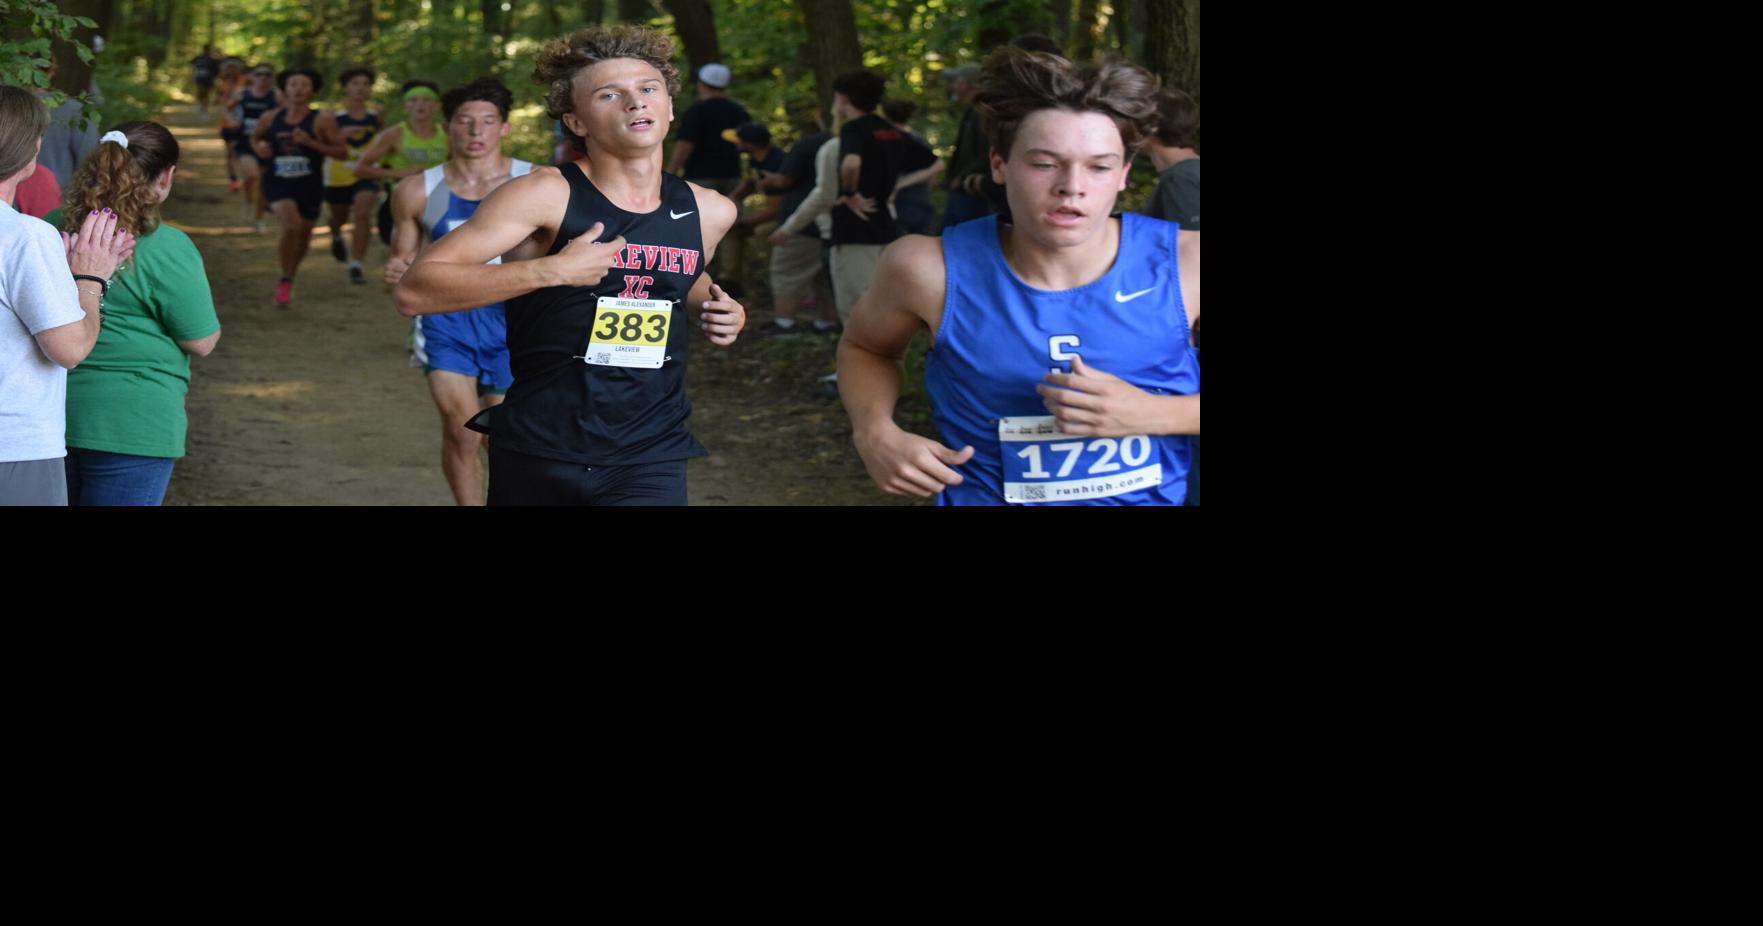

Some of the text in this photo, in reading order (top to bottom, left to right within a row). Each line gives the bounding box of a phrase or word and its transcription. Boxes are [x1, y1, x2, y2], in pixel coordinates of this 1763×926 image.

[608, 243, 699, 276] KEVIEW
[618, 275, 654, 299] XC
[595, 311, 666, 343] 383
[615, 345, 640, 353] LAKEVIEW
[1017, 434, 1151, 479] 1720
[1056, 476, 1144, 495] runhigh.com
